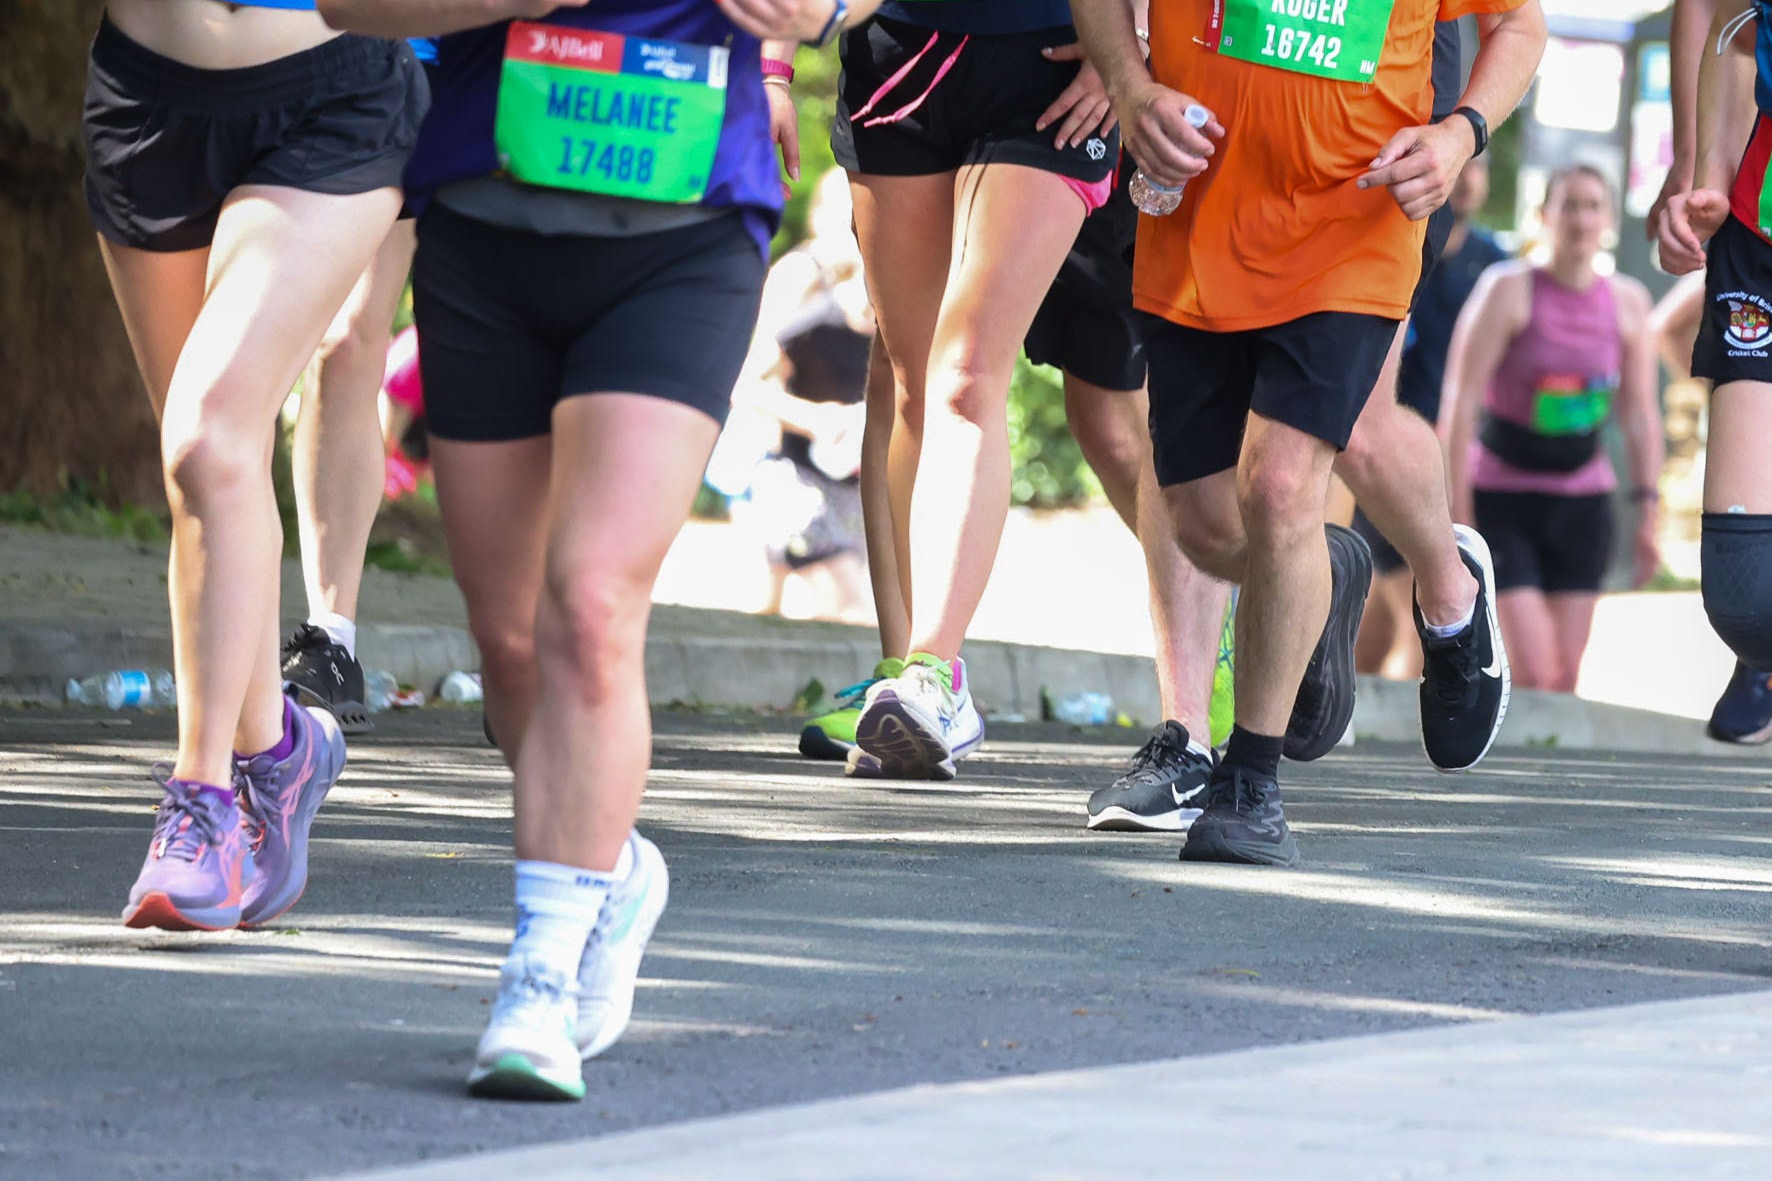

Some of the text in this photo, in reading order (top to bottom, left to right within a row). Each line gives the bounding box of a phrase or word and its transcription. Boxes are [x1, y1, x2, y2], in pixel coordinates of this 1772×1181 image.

[1261, 24, 1342, 69] 16742
[556, 136, 656, 185] 17488
[1751, 349, 1768, 357] Club
